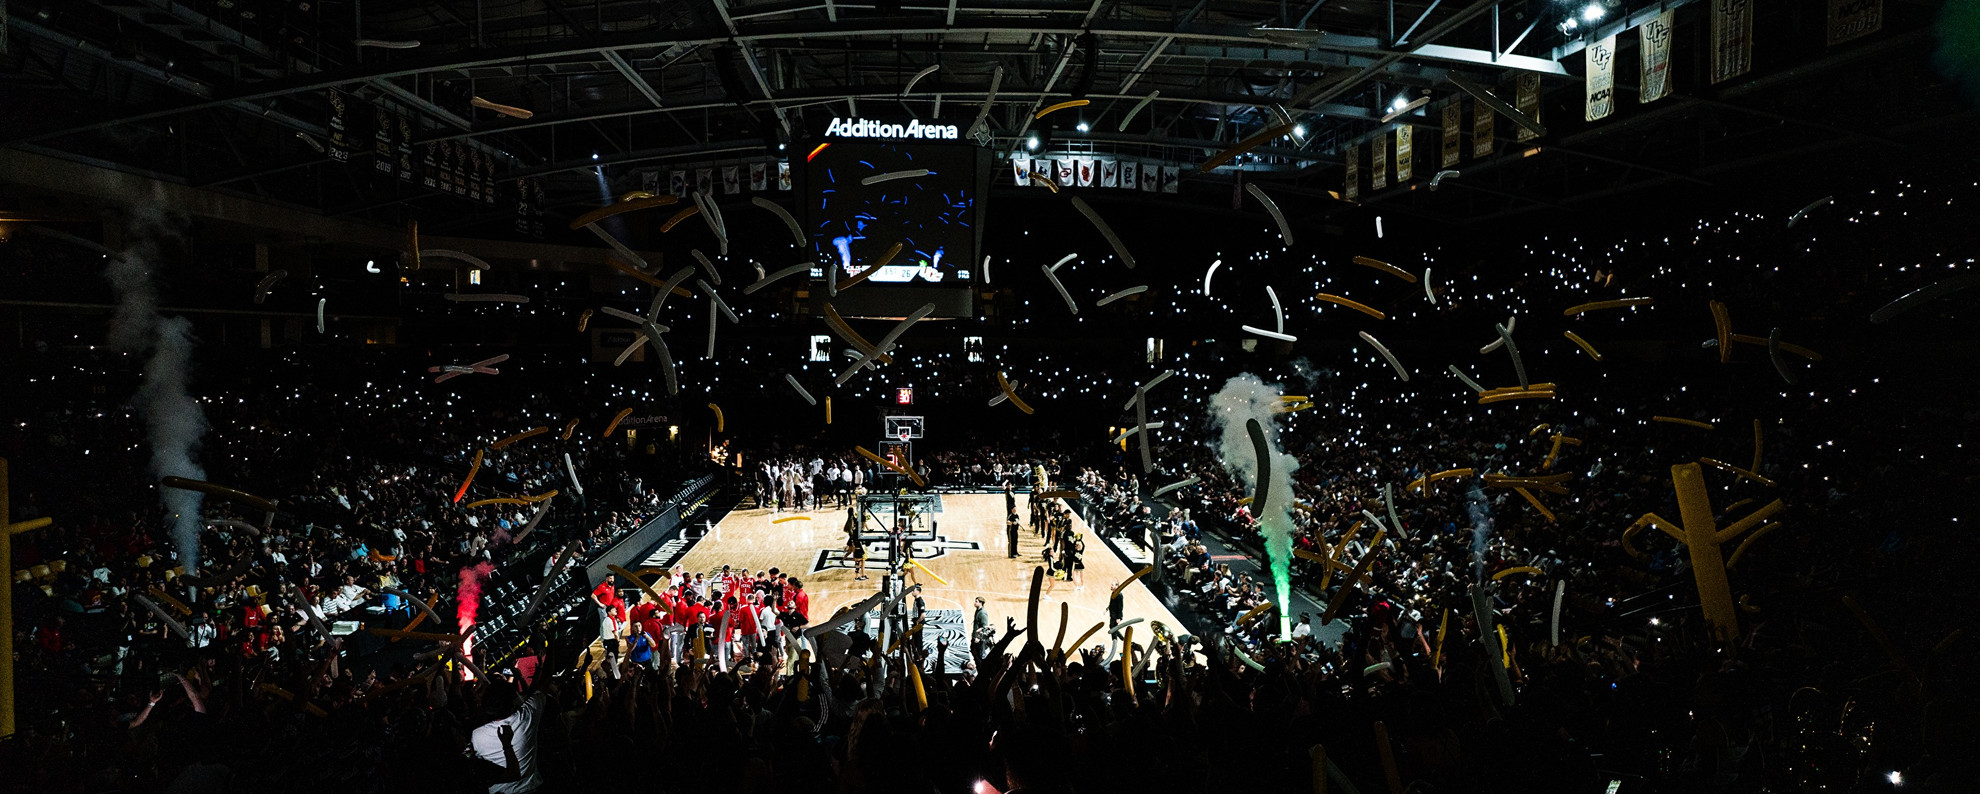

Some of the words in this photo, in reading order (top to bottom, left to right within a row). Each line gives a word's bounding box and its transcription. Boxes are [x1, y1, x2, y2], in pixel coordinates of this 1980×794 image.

[1646, 20, 1670, 49] UCF
[1591, 45, 1611, 71] UCF
[1590, 88, 1611, 103] NCAA
[825, 117, 905, 138] Addition
[904, 119, 958, 139] Arena
[901, 269, 911, 278] 26
